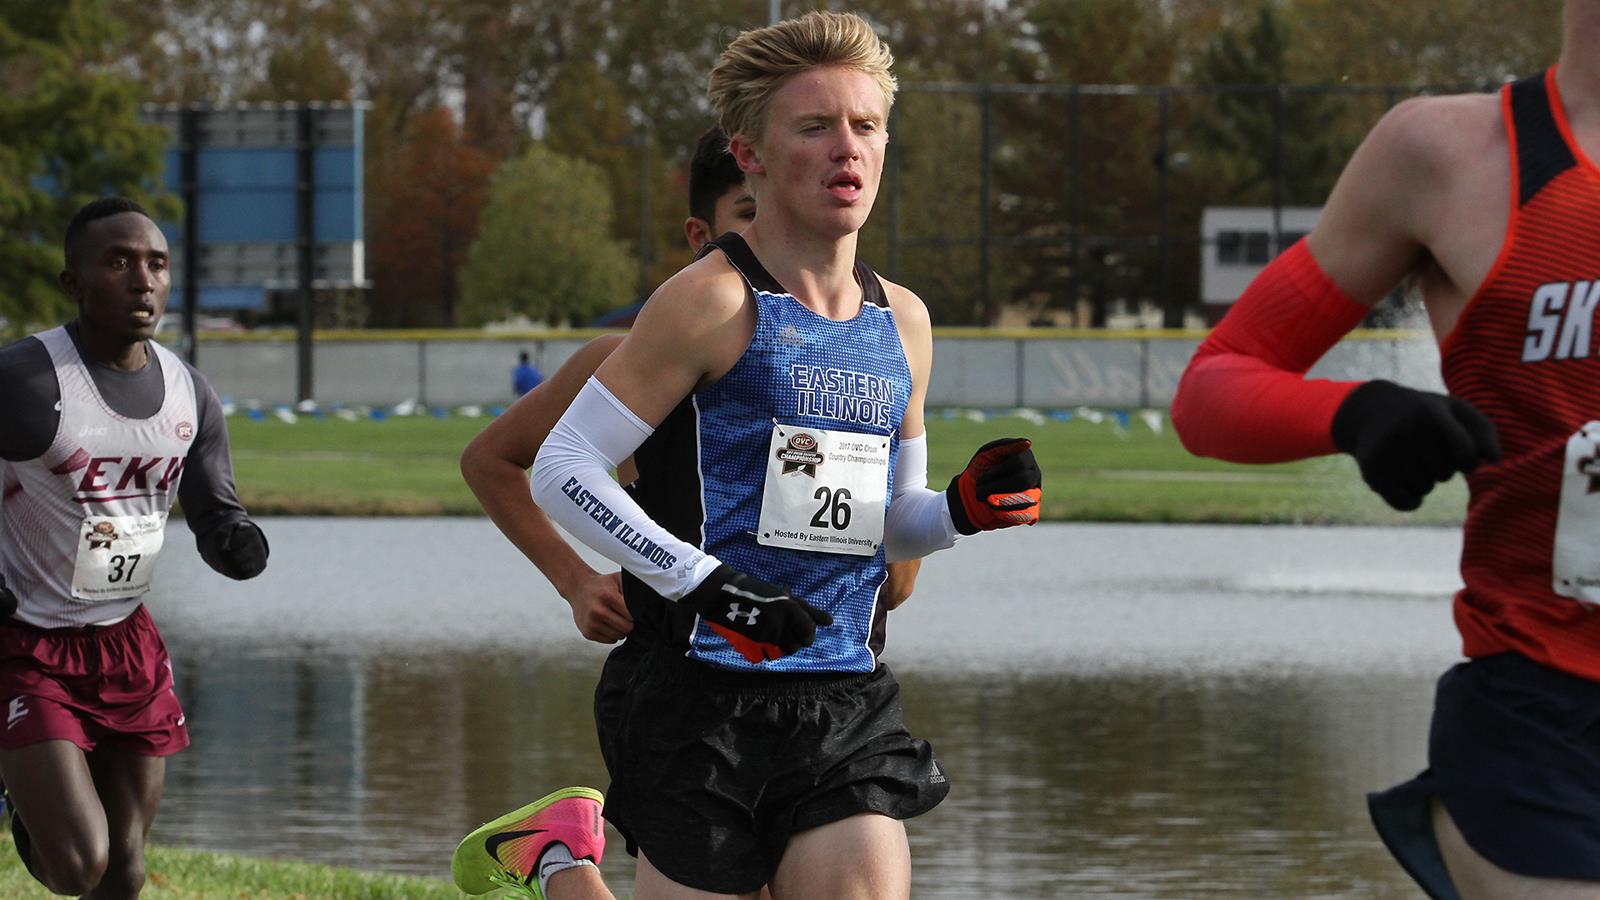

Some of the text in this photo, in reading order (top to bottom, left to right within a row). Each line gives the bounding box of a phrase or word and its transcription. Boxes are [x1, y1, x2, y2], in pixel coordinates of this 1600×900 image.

[1522, 280, 1600, 362] SK
[790, 365, 895, 404] EASTERN
[798, 391, 892, 428] ILLINOIS
[795, 437, 812, 445] OVC
[838, 442, 878, 453] 2017 OVC Cross
[828, 452, 846, 462] Country
[847, 454, 887, 466] Championships
[561, 476, 677, 571] EASTERN ILLINOIS
[809, 486, 852, 531] 26
[774, 529, 873, 547] Hosted By Eastern Illinois University
[107, 554, 141, 583] 37
